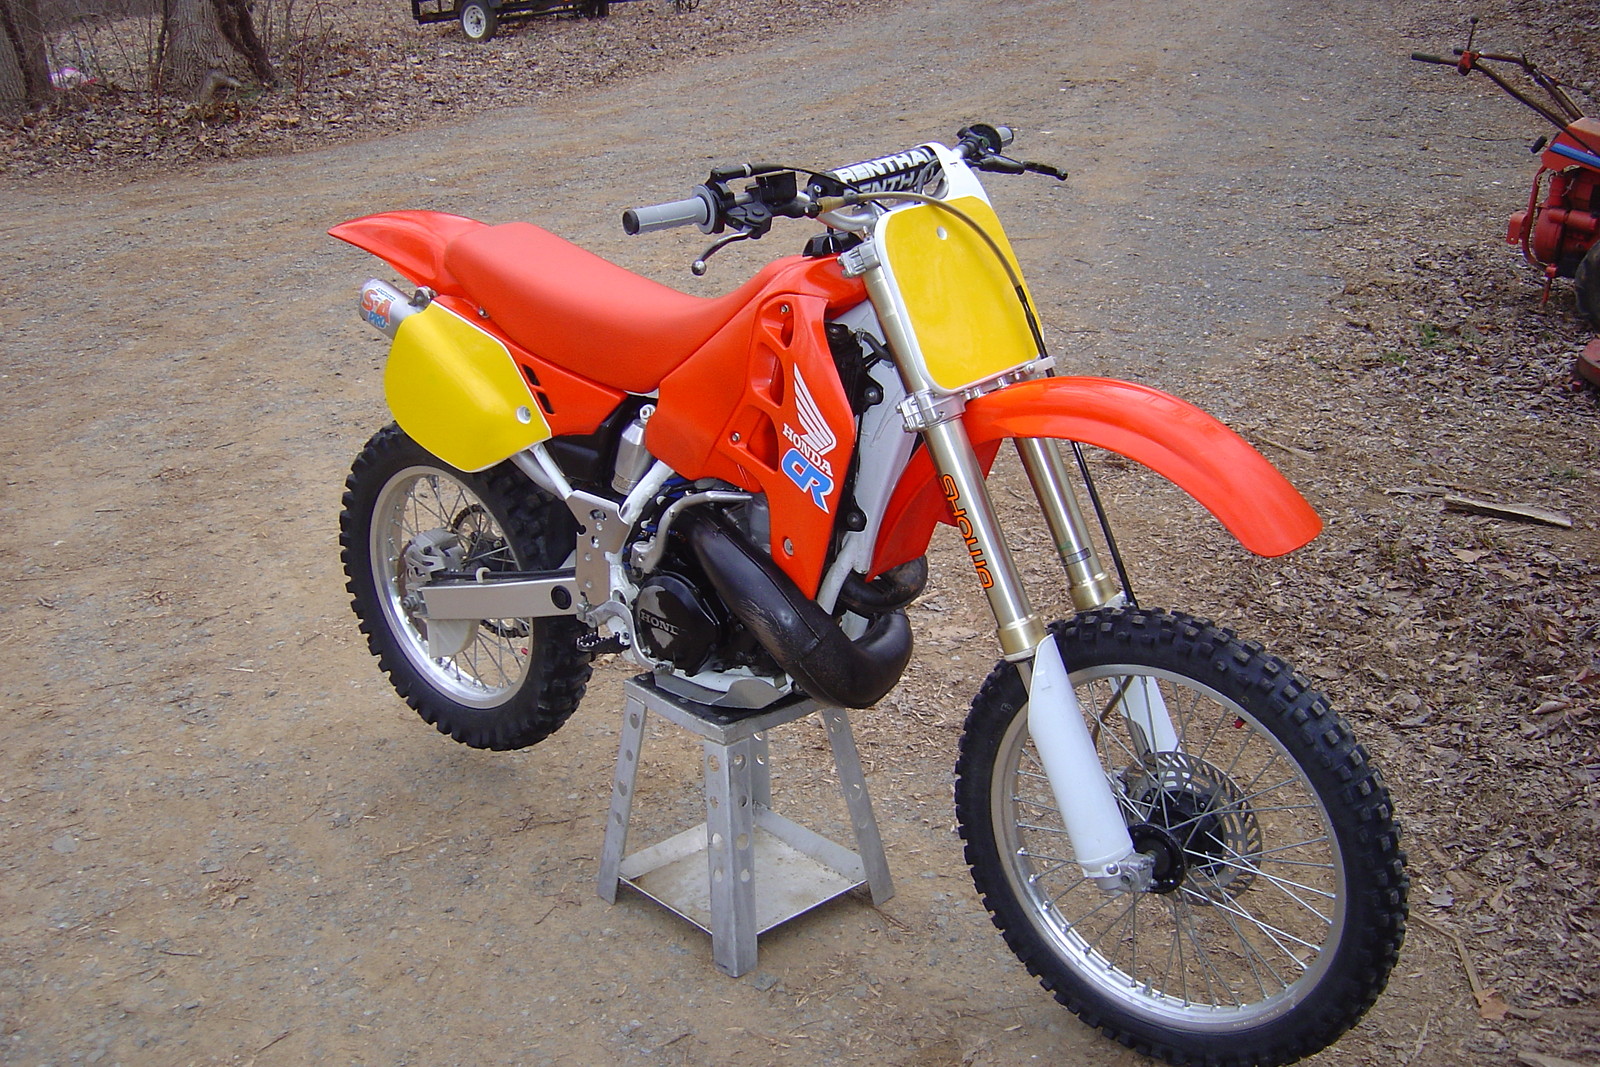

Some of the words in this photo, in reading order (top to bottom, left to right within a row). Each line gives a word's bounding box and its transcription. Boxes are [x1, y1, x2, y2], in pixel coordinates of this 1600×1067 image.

[833, 147, 938, 185] RENTHAL
[368, 311, 387, 329] PRO
[782, 422, 834, 477] HONDA
[781, 447, 835, 514] CR
[941, 473, 995, 589] SHOWA
[640, 611, 682, 636] HOND
